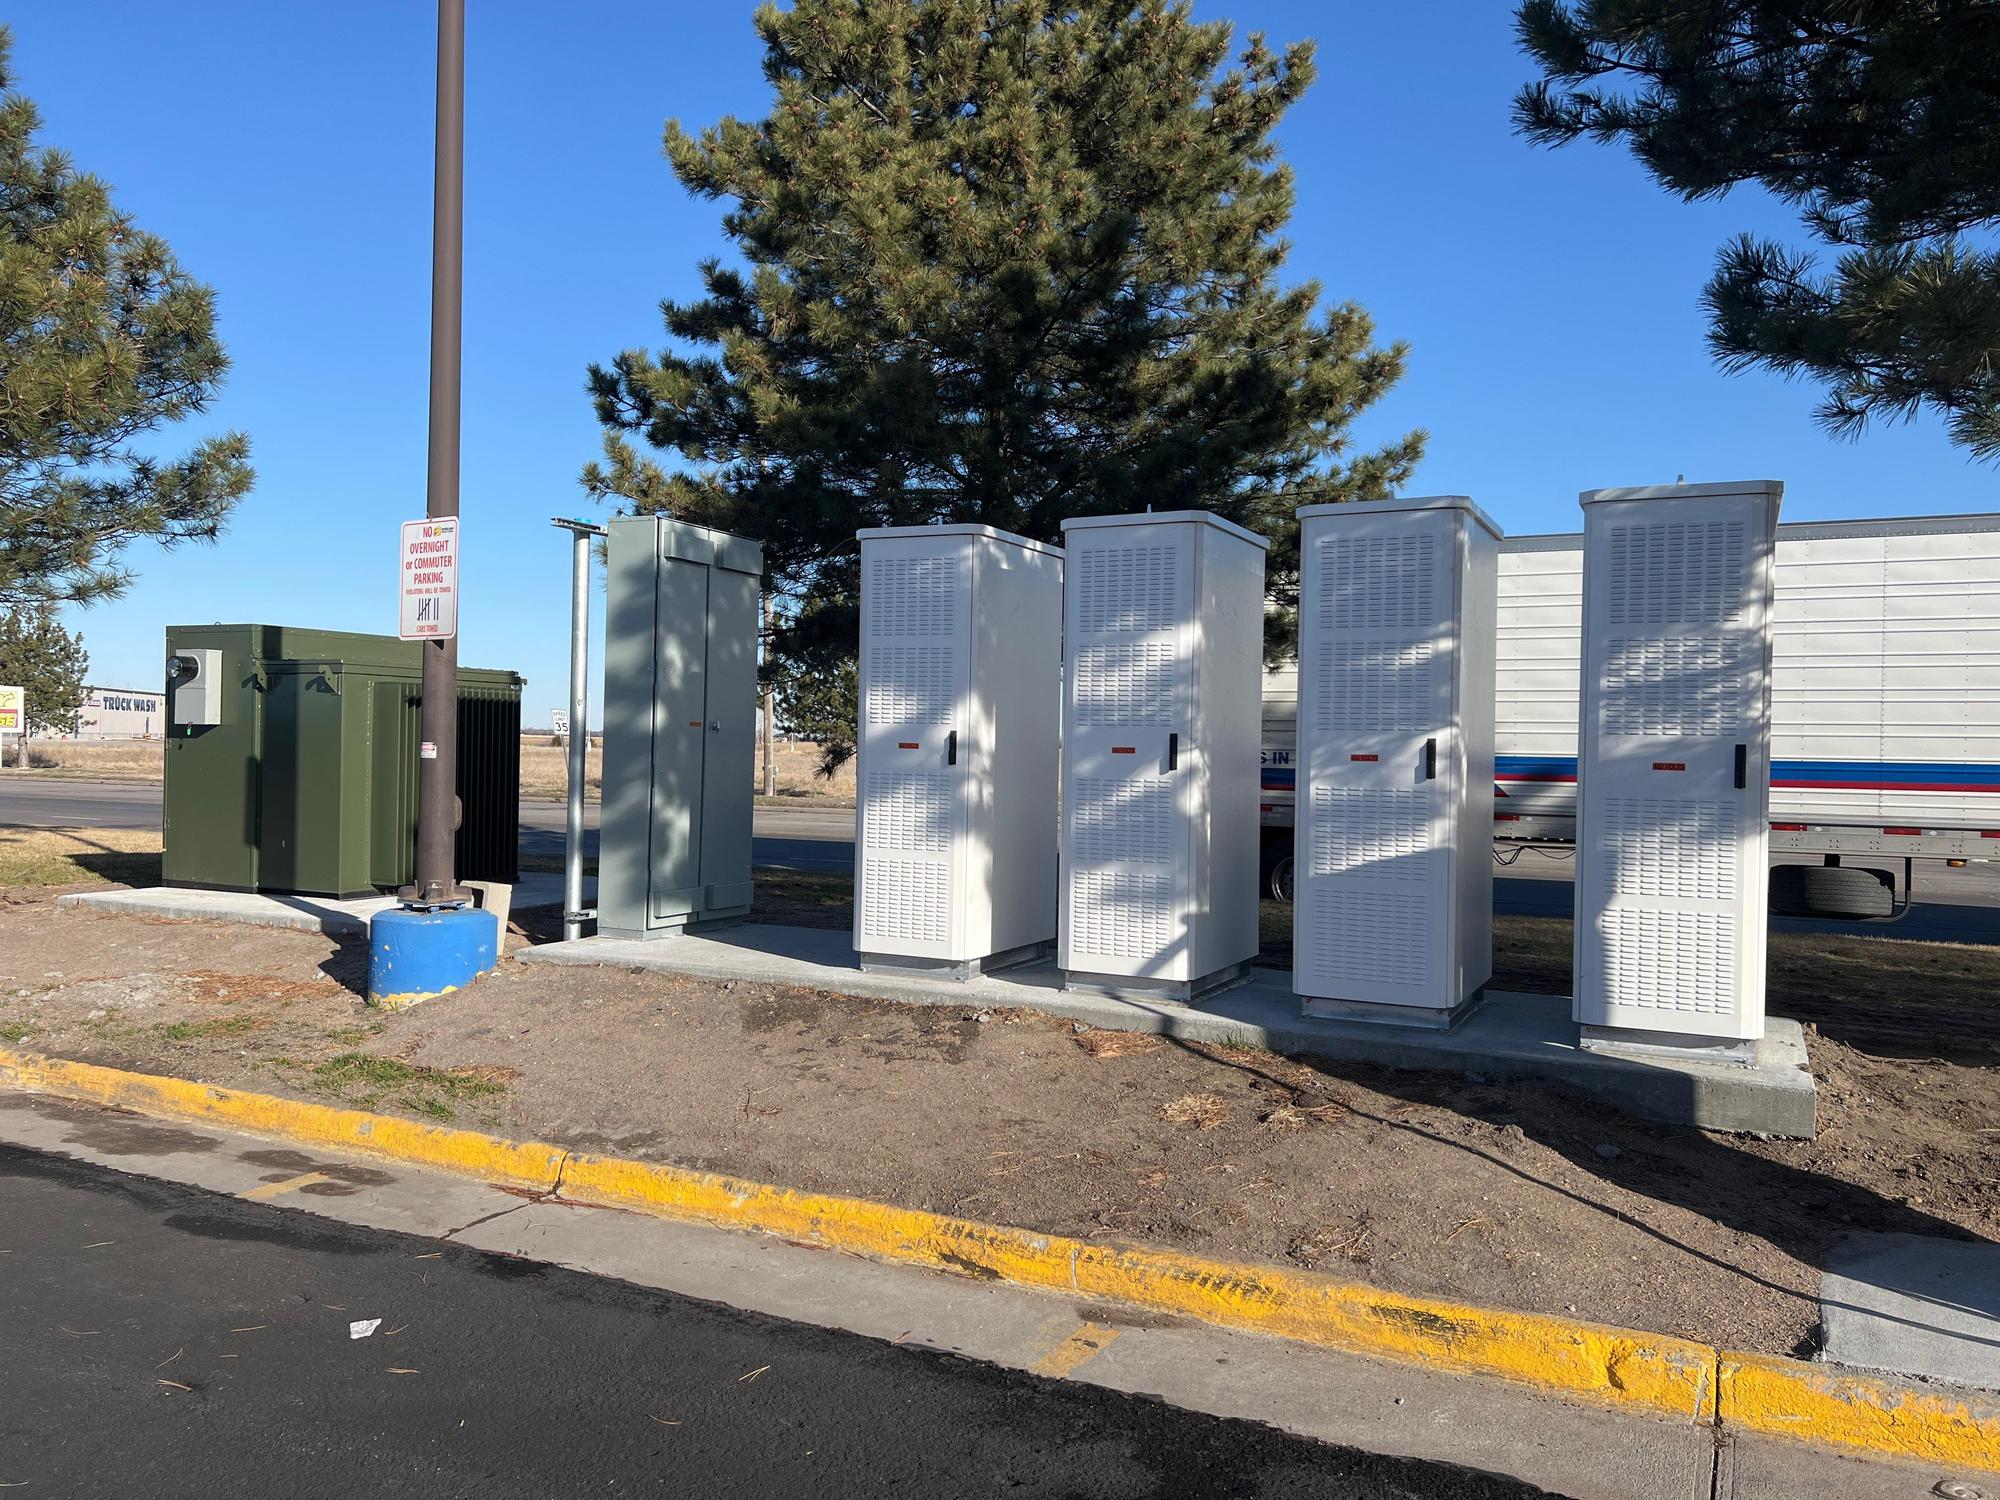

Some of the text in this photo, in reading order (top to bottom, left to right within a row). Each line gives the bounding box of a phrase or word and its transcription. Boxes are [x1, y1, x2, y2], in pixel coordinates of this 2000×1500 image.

[423, 527, 432, 538] NO
[410, 540, 449, 554] OVERNIGHT
[406, 555, 452, 570] or COMMUTER
[414, 572, 443, 584] PARKING
[426, 624, 438, 632] TOWED
[103, 696, 132, 711] TRUCK
[133, 699, 156, 712] WASH
[555, 722, 568, 732] 35
[1272, 752, 1289, 764] IN
